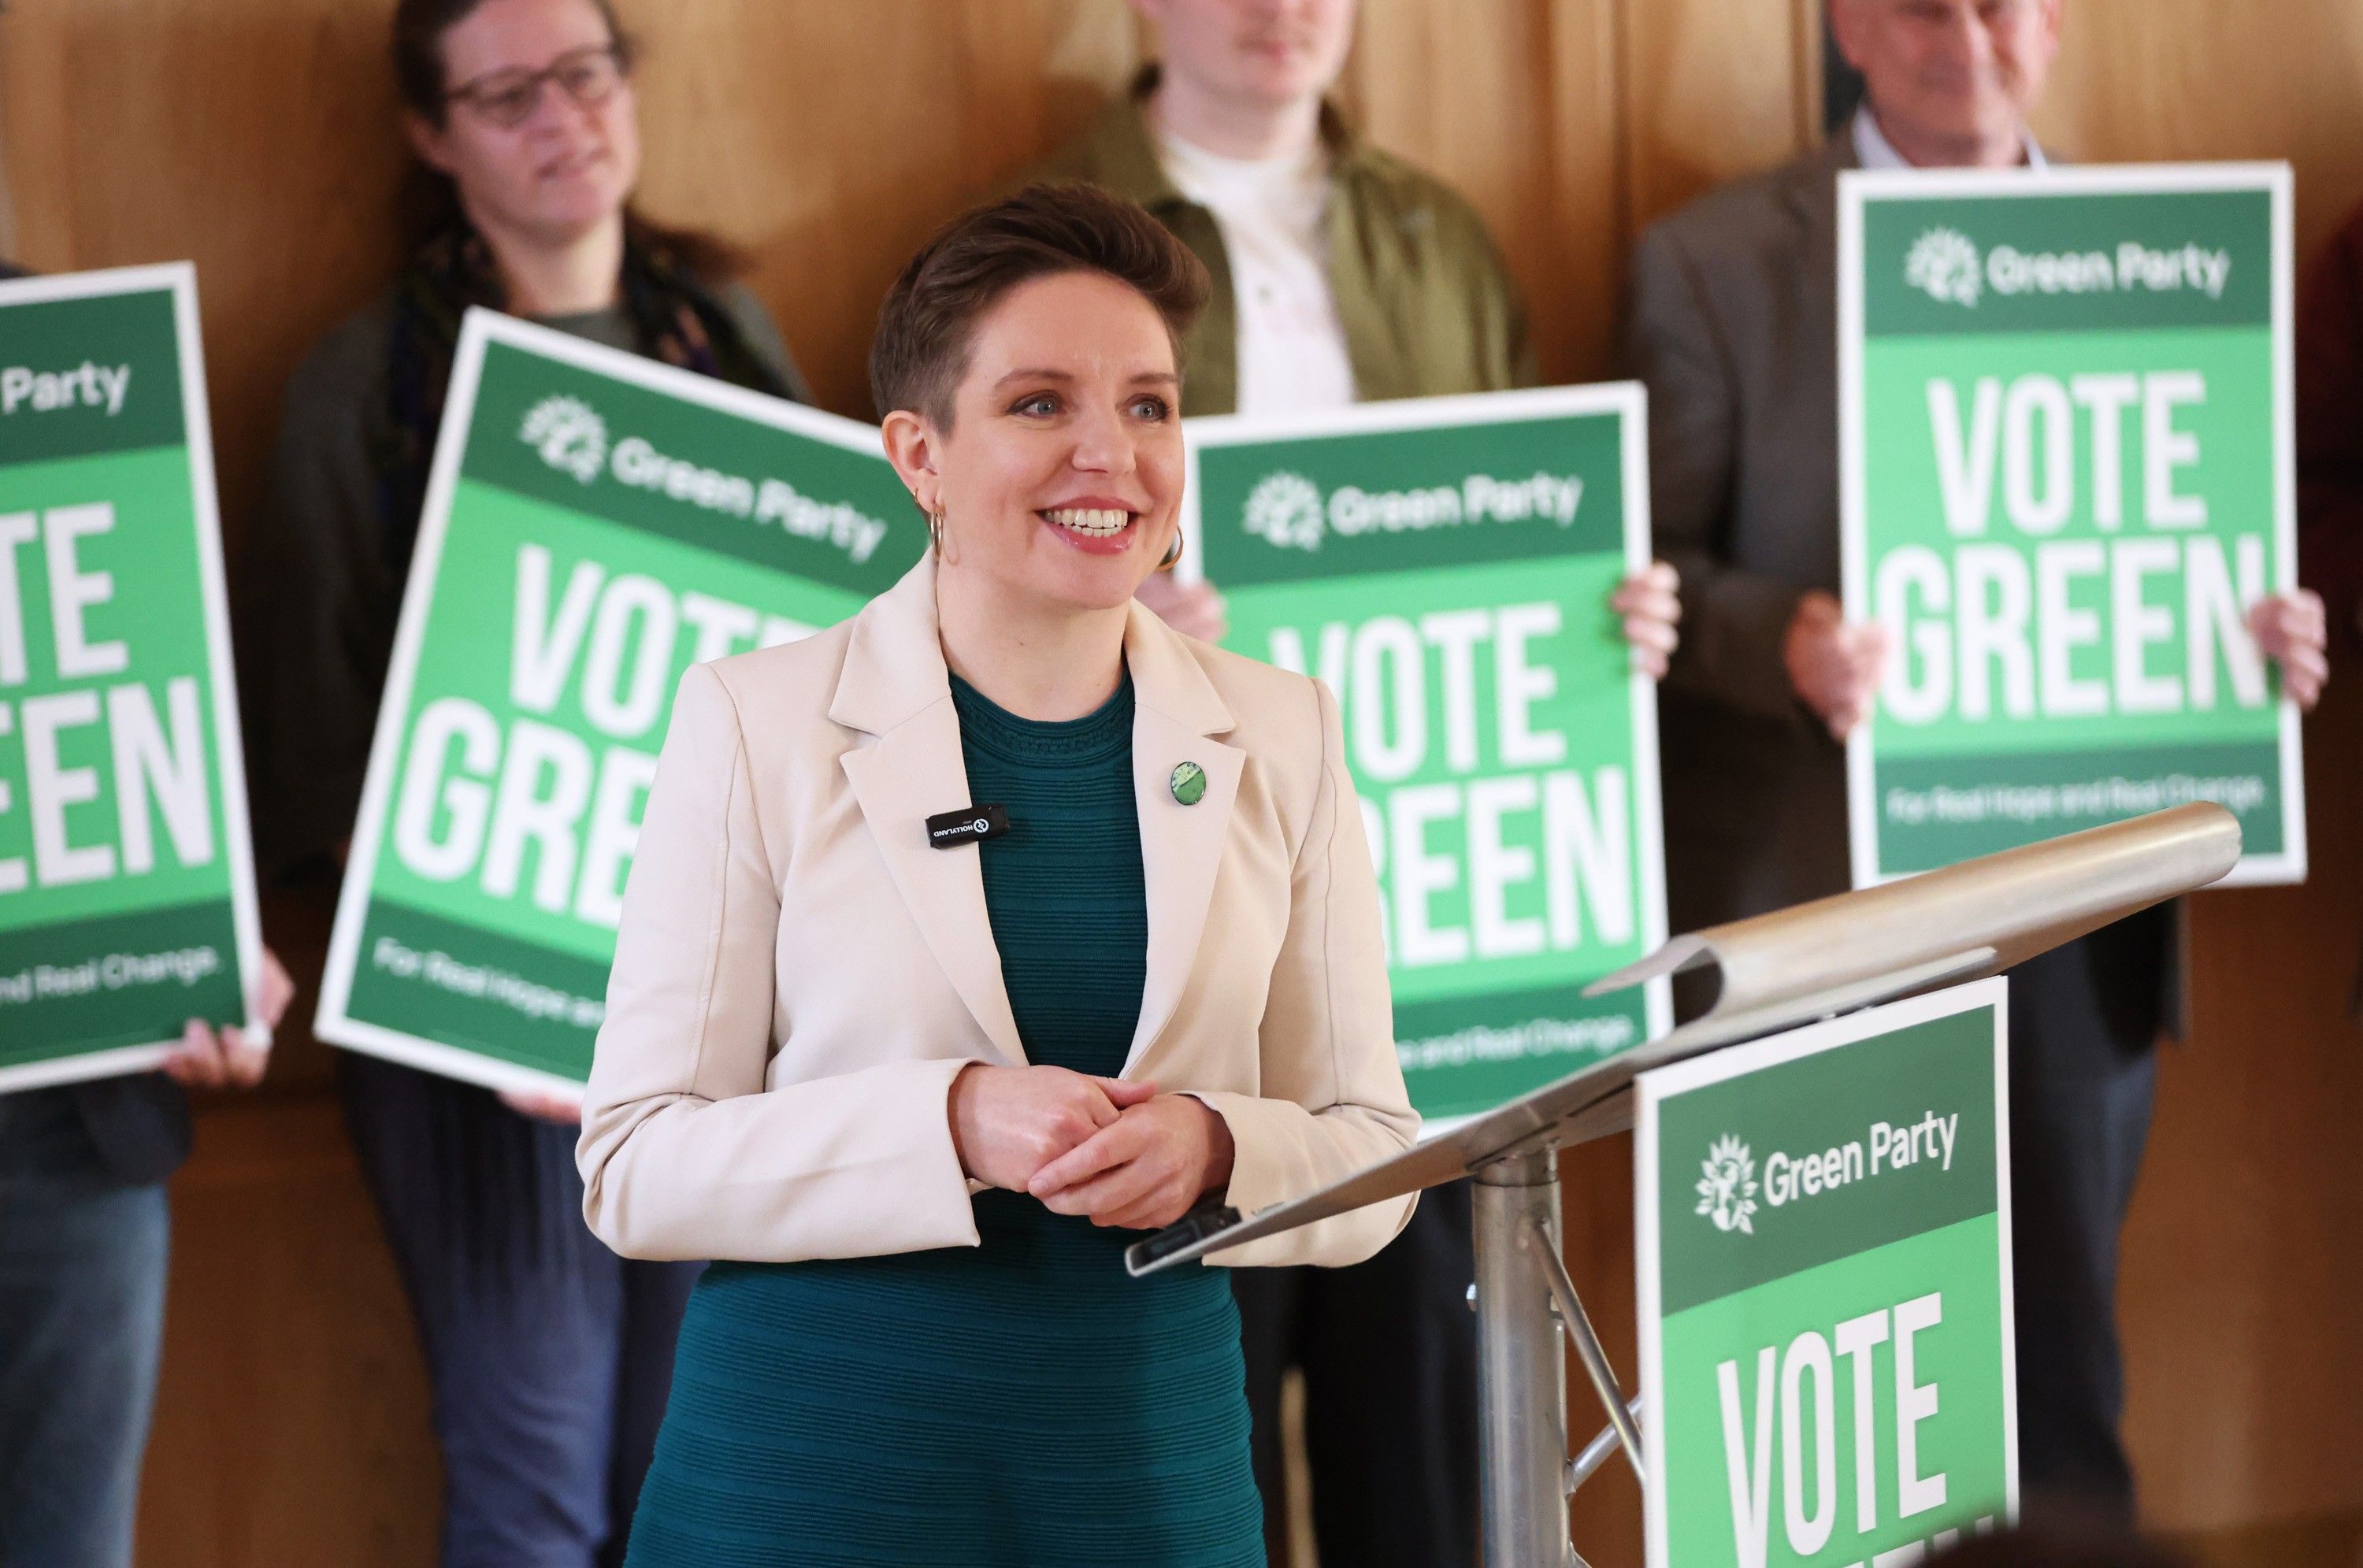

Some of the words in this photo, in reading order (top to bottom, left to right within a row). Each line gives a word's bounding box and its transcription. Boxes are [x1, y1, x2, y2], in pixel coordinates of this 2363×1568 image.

[1988, 244, 2113, 295] Green
[2116, 242, 2230, 298] Party
[2, 360, 130, 417] Party
[611, 437, 754, 520] Green
[755, 477, 887, 564] Party
[1329, 485, 1461, 536] Green
[1463, 471, 1583, 528] Party
[1927, 373, 2205, 534] VOTE
[0, 501, 128, 688] TE
[510, 543, 825, 739] VOT
[1875, 534, 2267, 726] GREEN
[394, 696, 660, 933] GRE
[933, 825, 974, 837] HOLLYLAND
[1358, 765, 1634, 969] EEN
[35, 958, 99, 997] Real
[373, 936, 422, 977] For
[1764, 1141, 1864, 1207] Green
[1870, 1110, 1959, 1176] Party
[1716, 1292, 1947, 1568] VOTE
